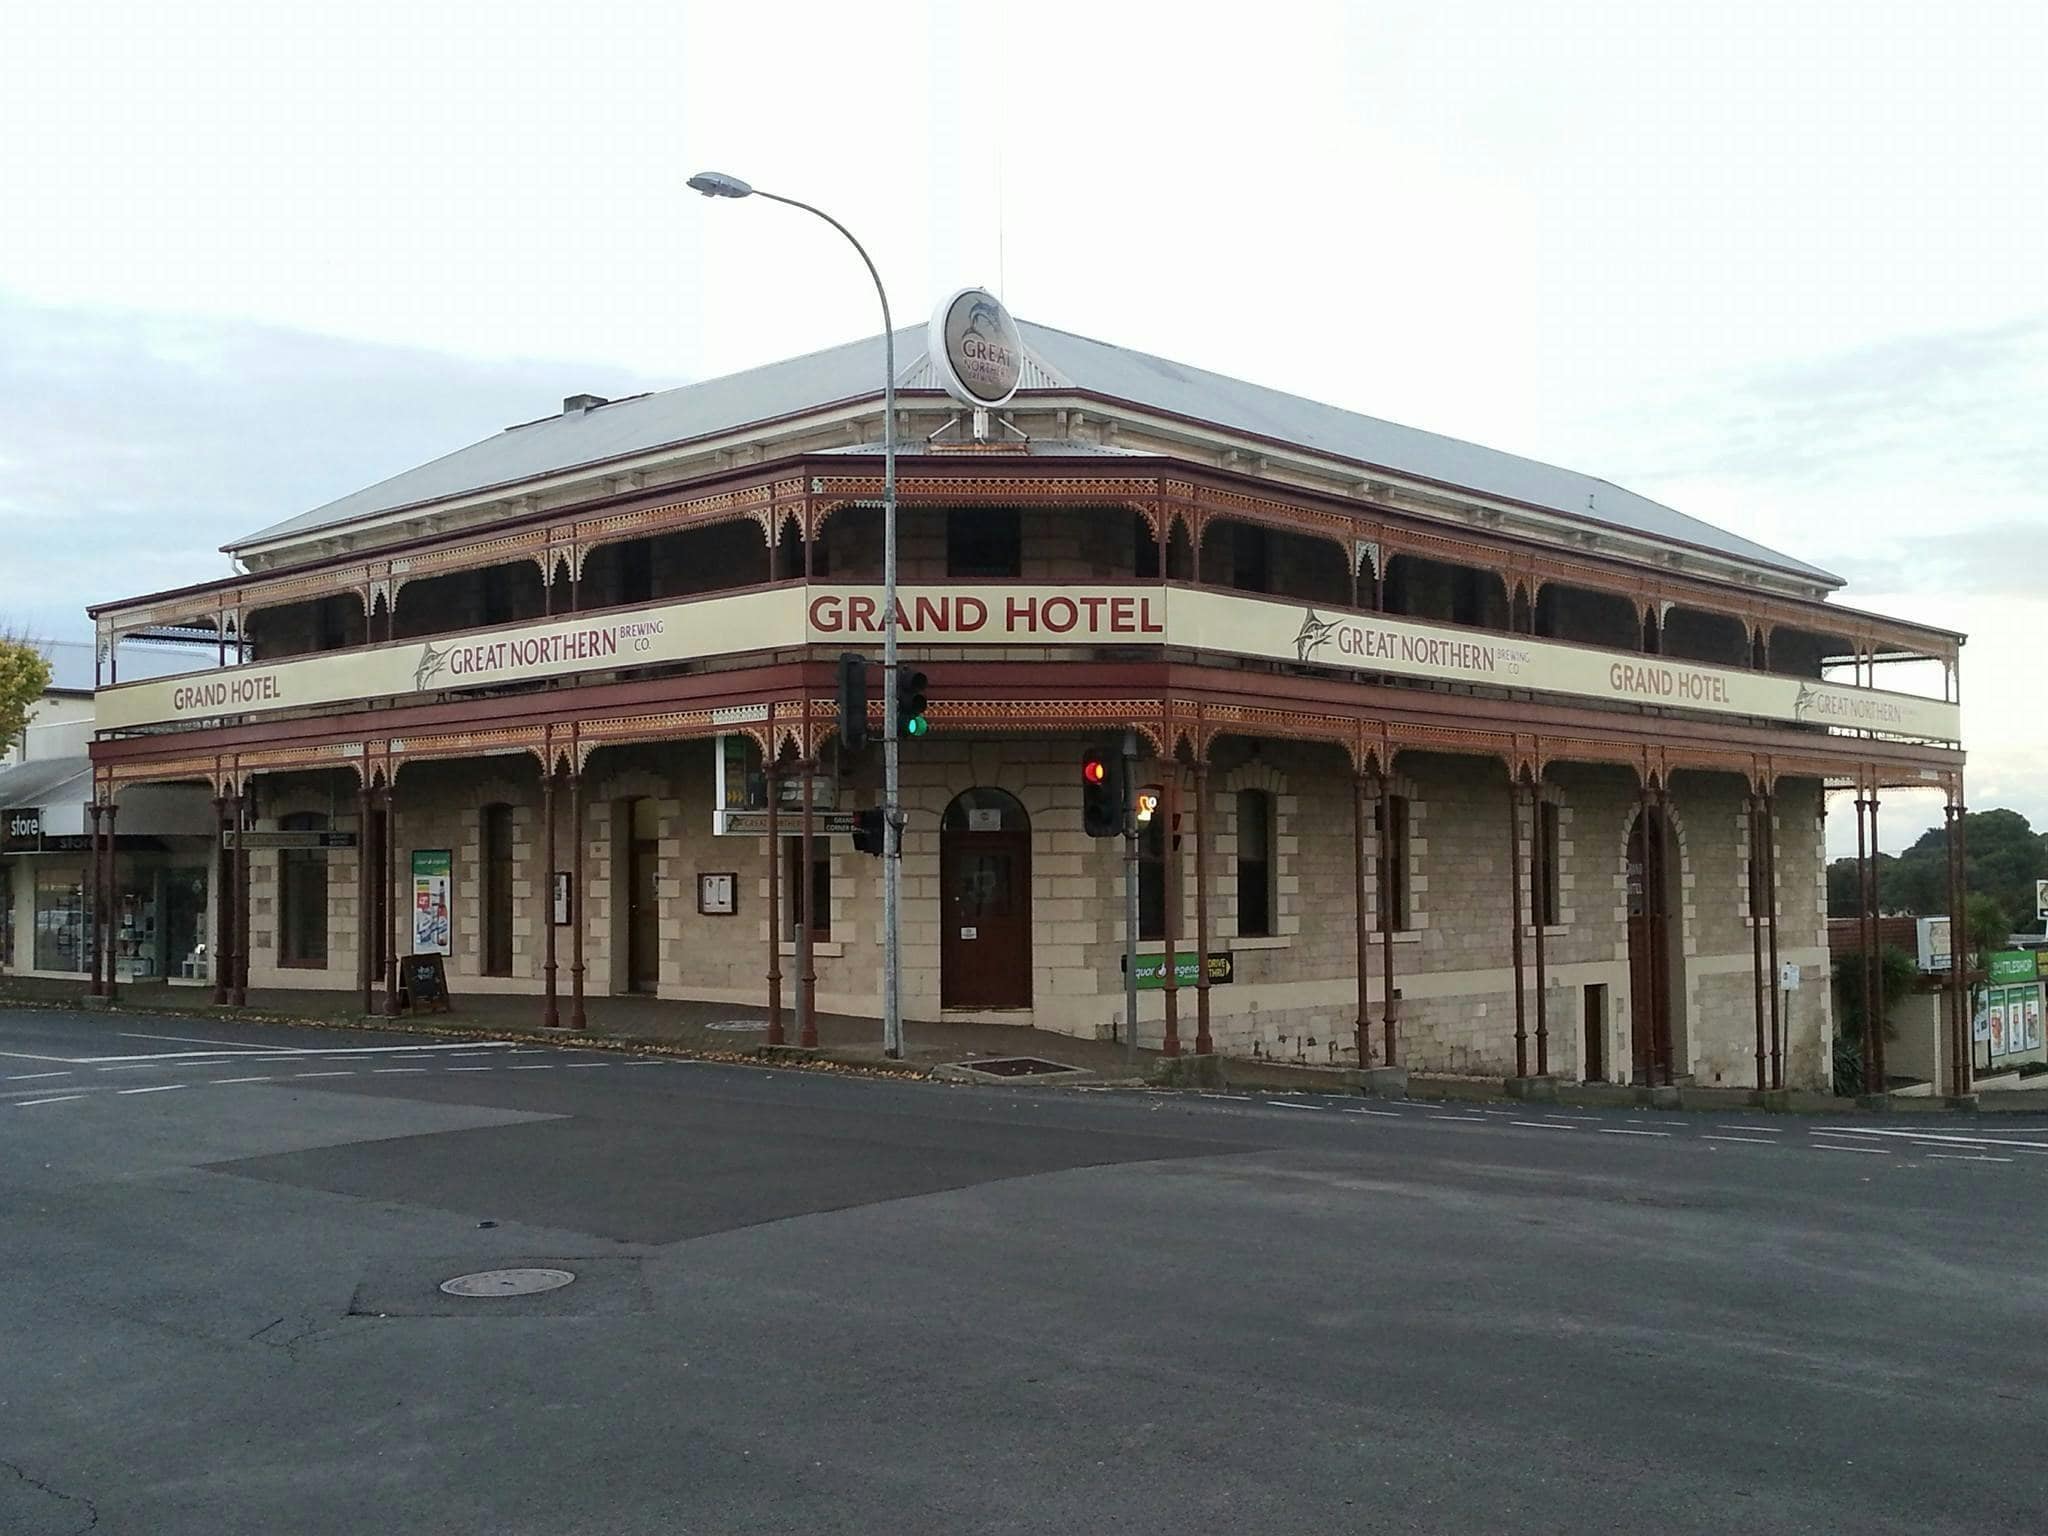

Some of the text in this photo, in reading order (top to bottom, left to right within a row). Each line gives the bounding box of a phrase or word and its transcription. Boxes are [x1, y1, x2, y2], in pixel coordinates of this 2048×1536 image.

[963, 339, 1010, 366] GREAT
[809, 596, 1163, 632] GRAND HOTEL
[620, 620, 663, 638] BREWING
[450, 627, 616, 675] GREAT NORTHERN
[1338, 626, 1494, 672] GREAT NORTHERN
[174, 676, 280, 710] GRAND HOTEL
[1610, 663, 1729, 703] GRAND HOTEL
[1817, 694, 1849, 715] GREAT
[1851, 699, 1902, 722] NORTHERN
[11, 815, 38, 836] store
[1135, 967, 1155, 979] quor
[1207, 958, 1226, 968] DRIVE
[1208, 968, 1225, 977] THRU
